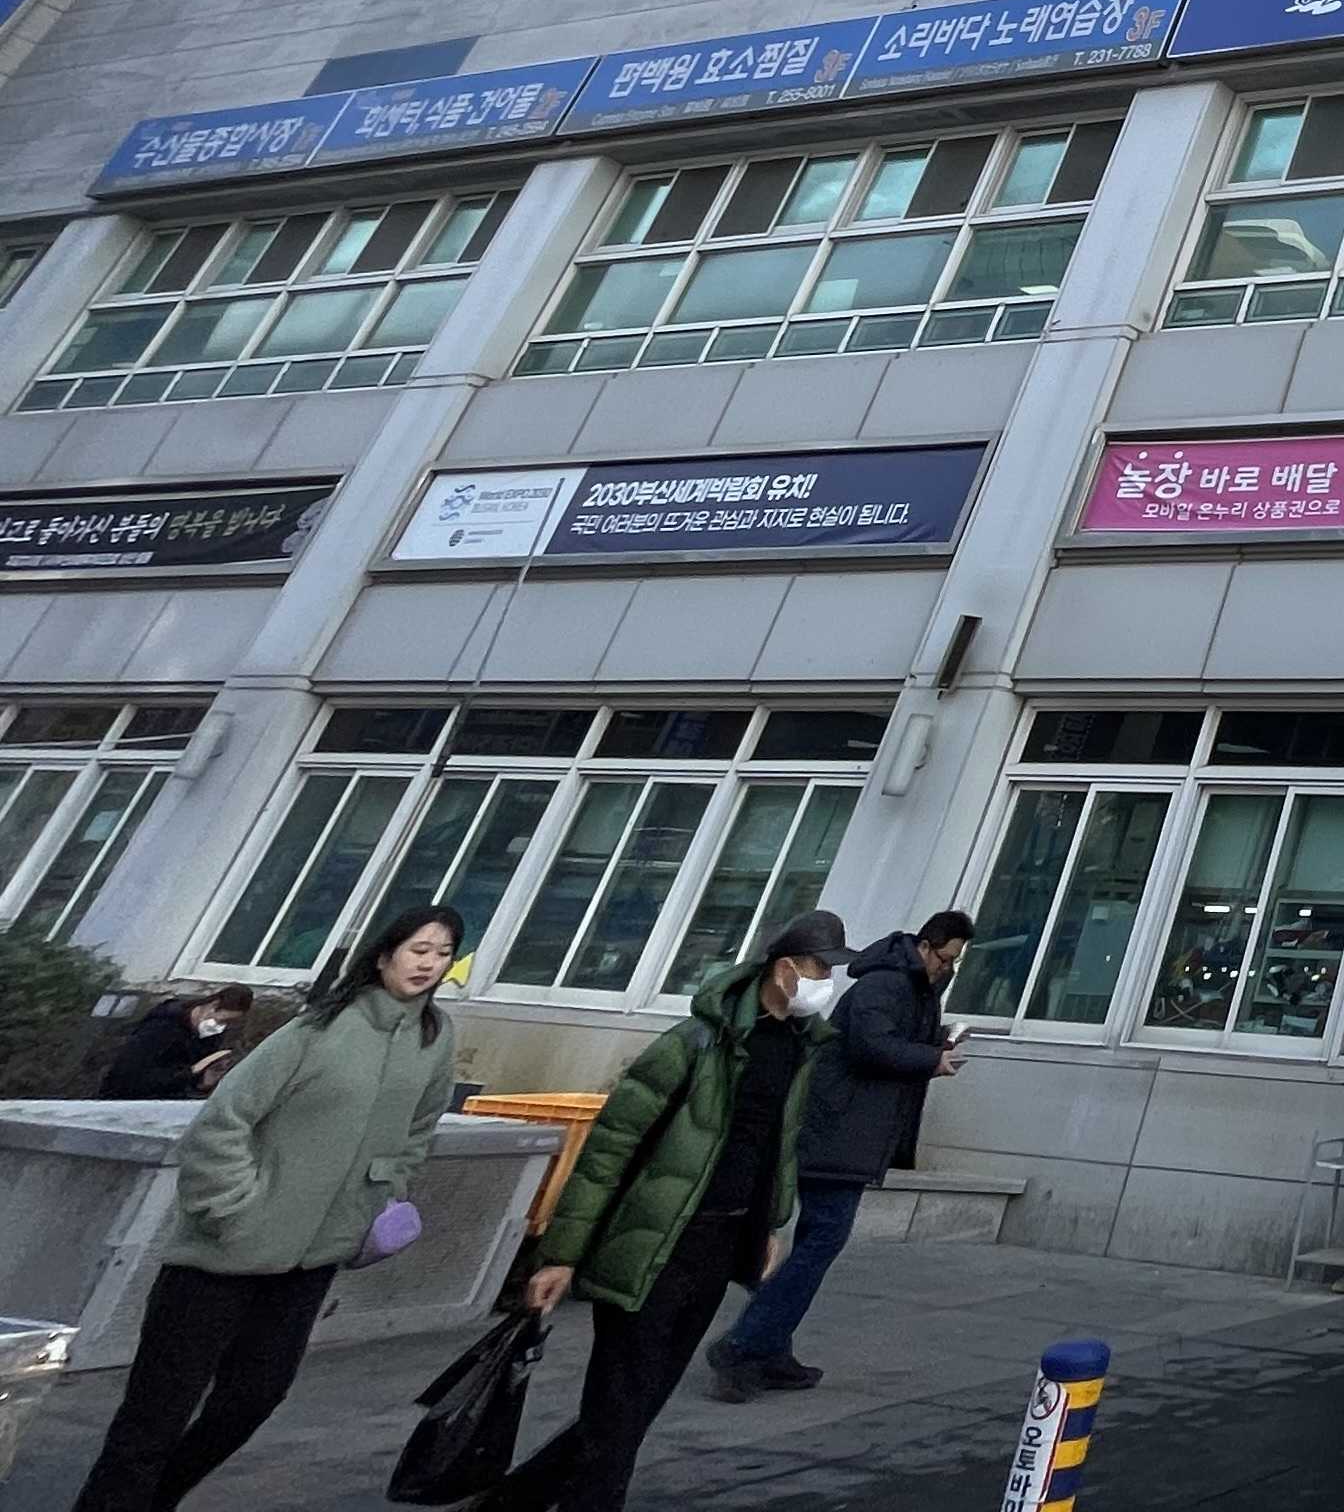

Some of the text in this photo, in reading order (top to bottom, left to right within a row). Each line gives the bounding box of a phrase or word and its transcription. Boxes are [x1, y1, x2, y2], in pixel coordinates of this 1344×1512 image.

[877, 12, 991, 61] 소리바다
[694, 37, 820, 85] 효소찜질
[582, 473, 818, 507] 2030부산세계박람회 유치!
[1199, 464, 1260, 494] 바로
[1271, 461, 1337, 494] 배달
[601, 512, 664, 533] 여러분의
[660, 510, 709, 532] 뜨거운
[707, 508, 758, 531] 관심과
[757, 506, 808, 529] 지지로
[806, 504, 859, 528] 현실이
[1142, 500, 1192, 521] 모바일
[1196, 499, 1248, 520] 온누리
[1253, 498, 1338, 520] 상품권으로
